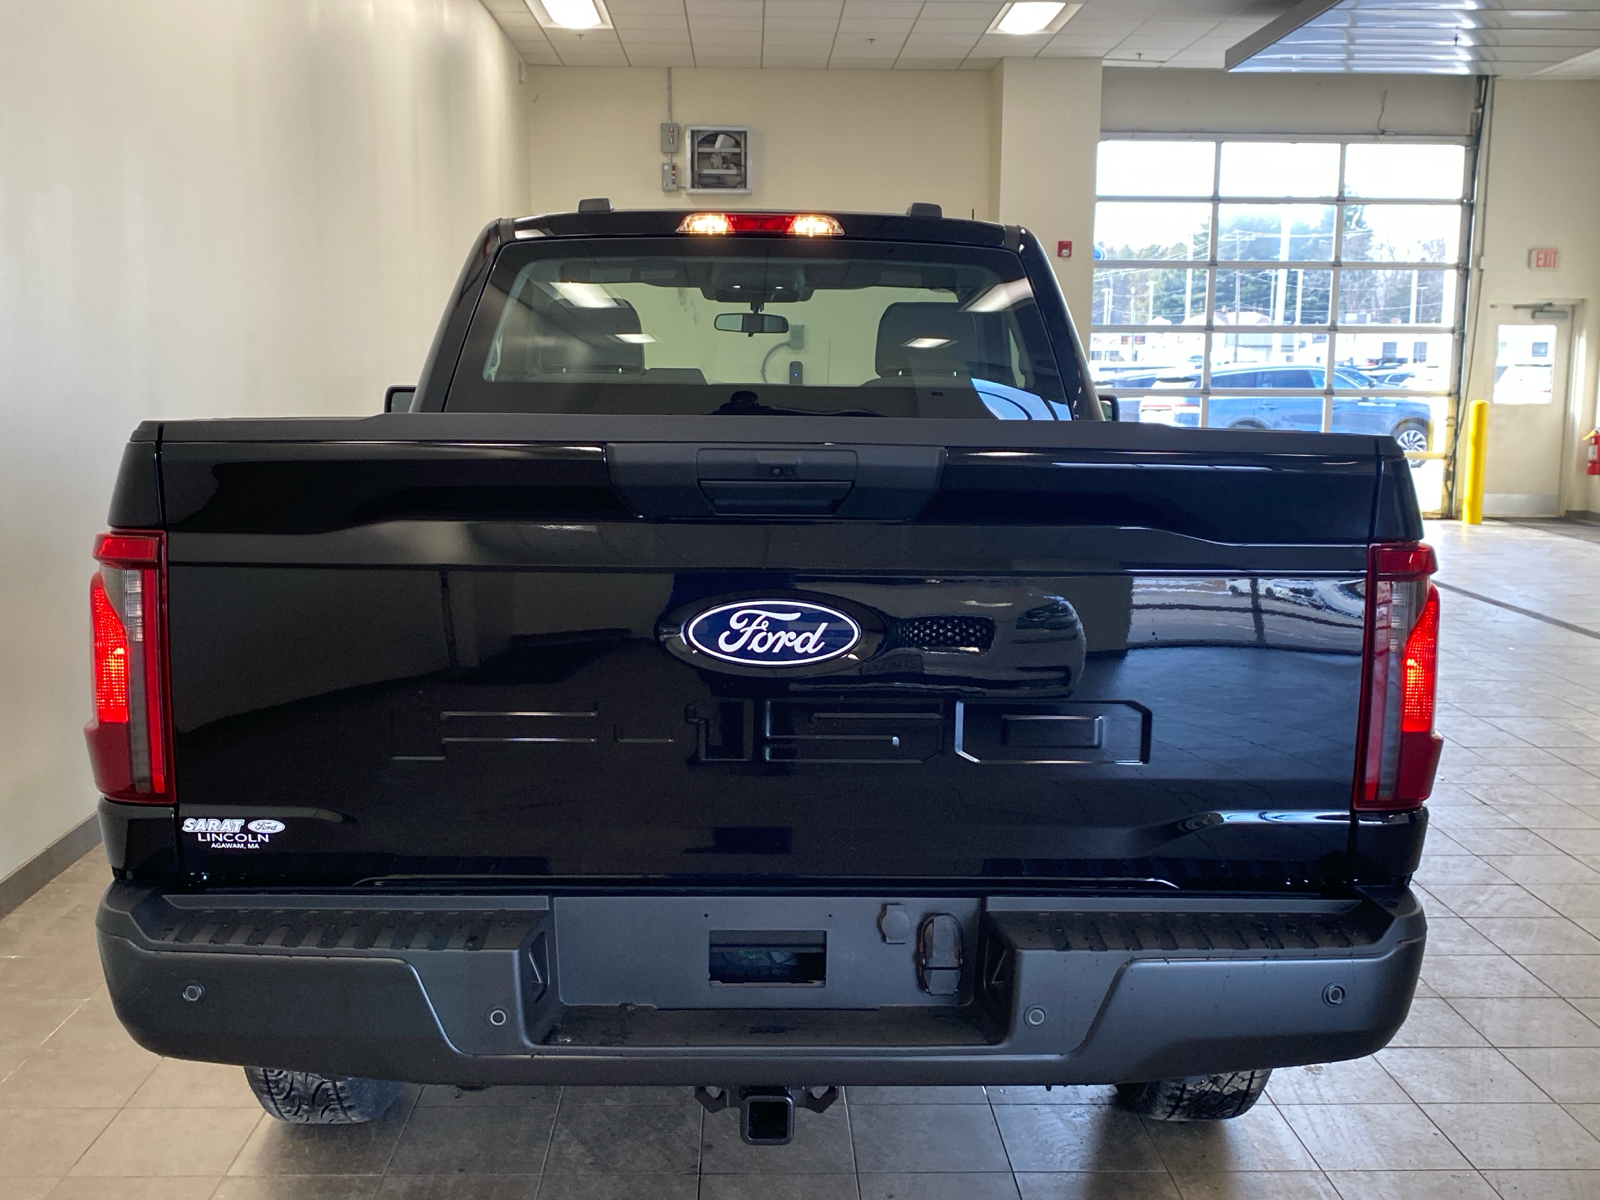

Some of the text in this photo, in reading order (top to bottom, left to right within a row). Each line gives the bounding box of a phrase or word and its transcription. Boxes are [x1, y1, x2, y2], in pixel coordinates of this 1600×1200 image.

[1535, 250, 1558, 268] EXIT
[718, 609, 829, 654] Ford
[181, 818, 245, 833] SARAT
[197, 833, 270, 842] LINCOLN
[211, 842, 247, 850] AGAWAM,
